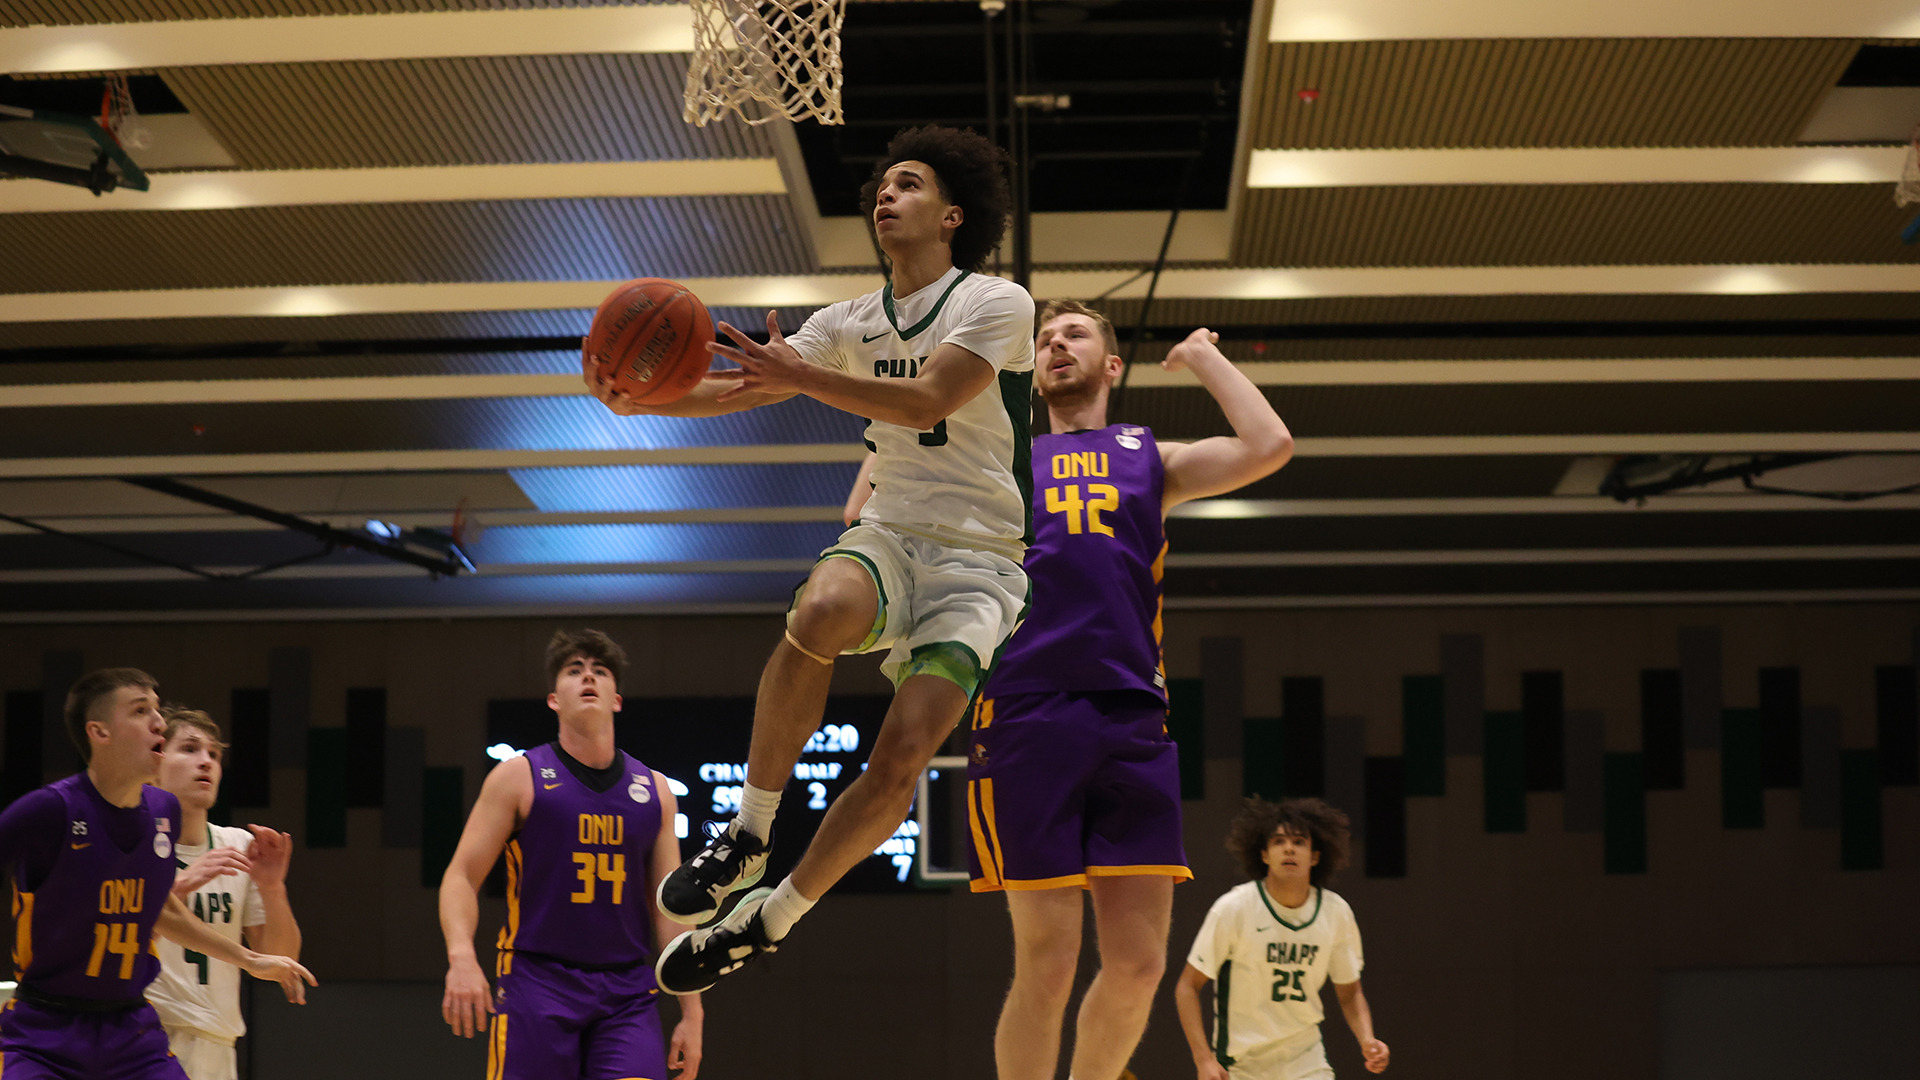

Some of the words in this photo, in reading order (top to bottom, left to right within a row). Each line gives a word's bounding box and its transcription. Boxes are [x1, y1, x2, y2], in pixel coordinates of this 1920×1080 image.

[1052, 451, 1109, 479] ONU
[1044, 483, 1120, 538] 42
[807, 782, 828, 810] 2
[578, 813, 624, 845] ONU
[570, 851, 627, 905] 34
[891, 854, 913, 882] 7
[98, 878, 146, 914] ONU
[85, 922, 139, 980] 14
[1267, 941, 1319, 966] CHAPS
[1272, 968, 1307, 1002] 25
